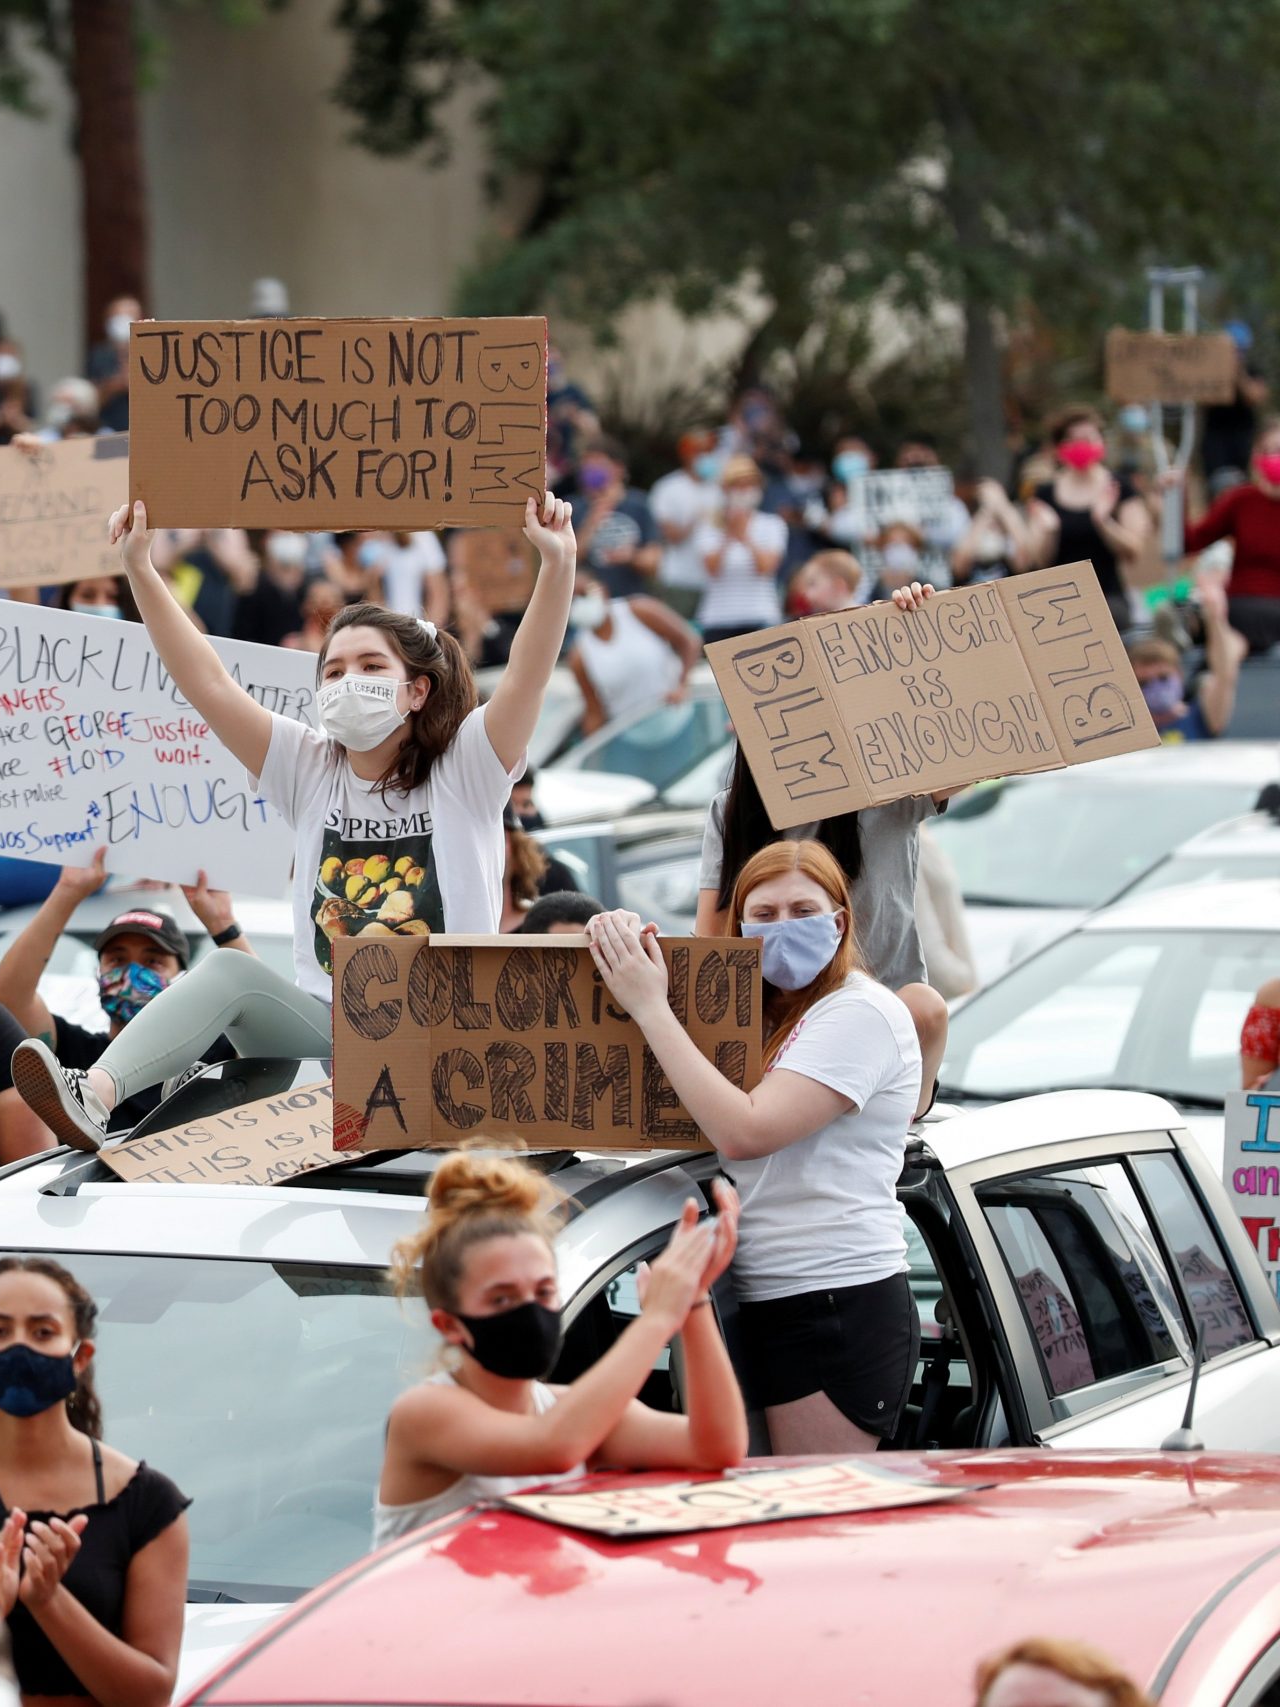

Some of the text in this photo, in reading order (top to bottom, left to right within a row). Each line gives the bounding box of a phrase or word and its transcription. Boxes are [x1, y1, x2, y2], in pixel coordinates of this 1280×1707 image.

[137, 328, 480, 388] JUSTICE IS NOT
[176, 393, 476, 444] TOO MUCH TO
[470, 342, 542, 505] BLM
[241, 444, 453, 502] ASK FOR!
[817, 589, 1013, 683] ENOUGH
[1017, 582, 1135, 747] BLM
[44, 710, 135, 751] GEORGE
[732, 636, 850, 800] BLM
[855, 692, 1056, 785] ENOUGH
[341, 942, 581, 1041] COLOR
[361, 1064, 408, 1134] A
[111, 1125, 215, 1162] THIS
[218, 1110, 258, 1130] IS
[265, 1131, 304, 1150] IS
